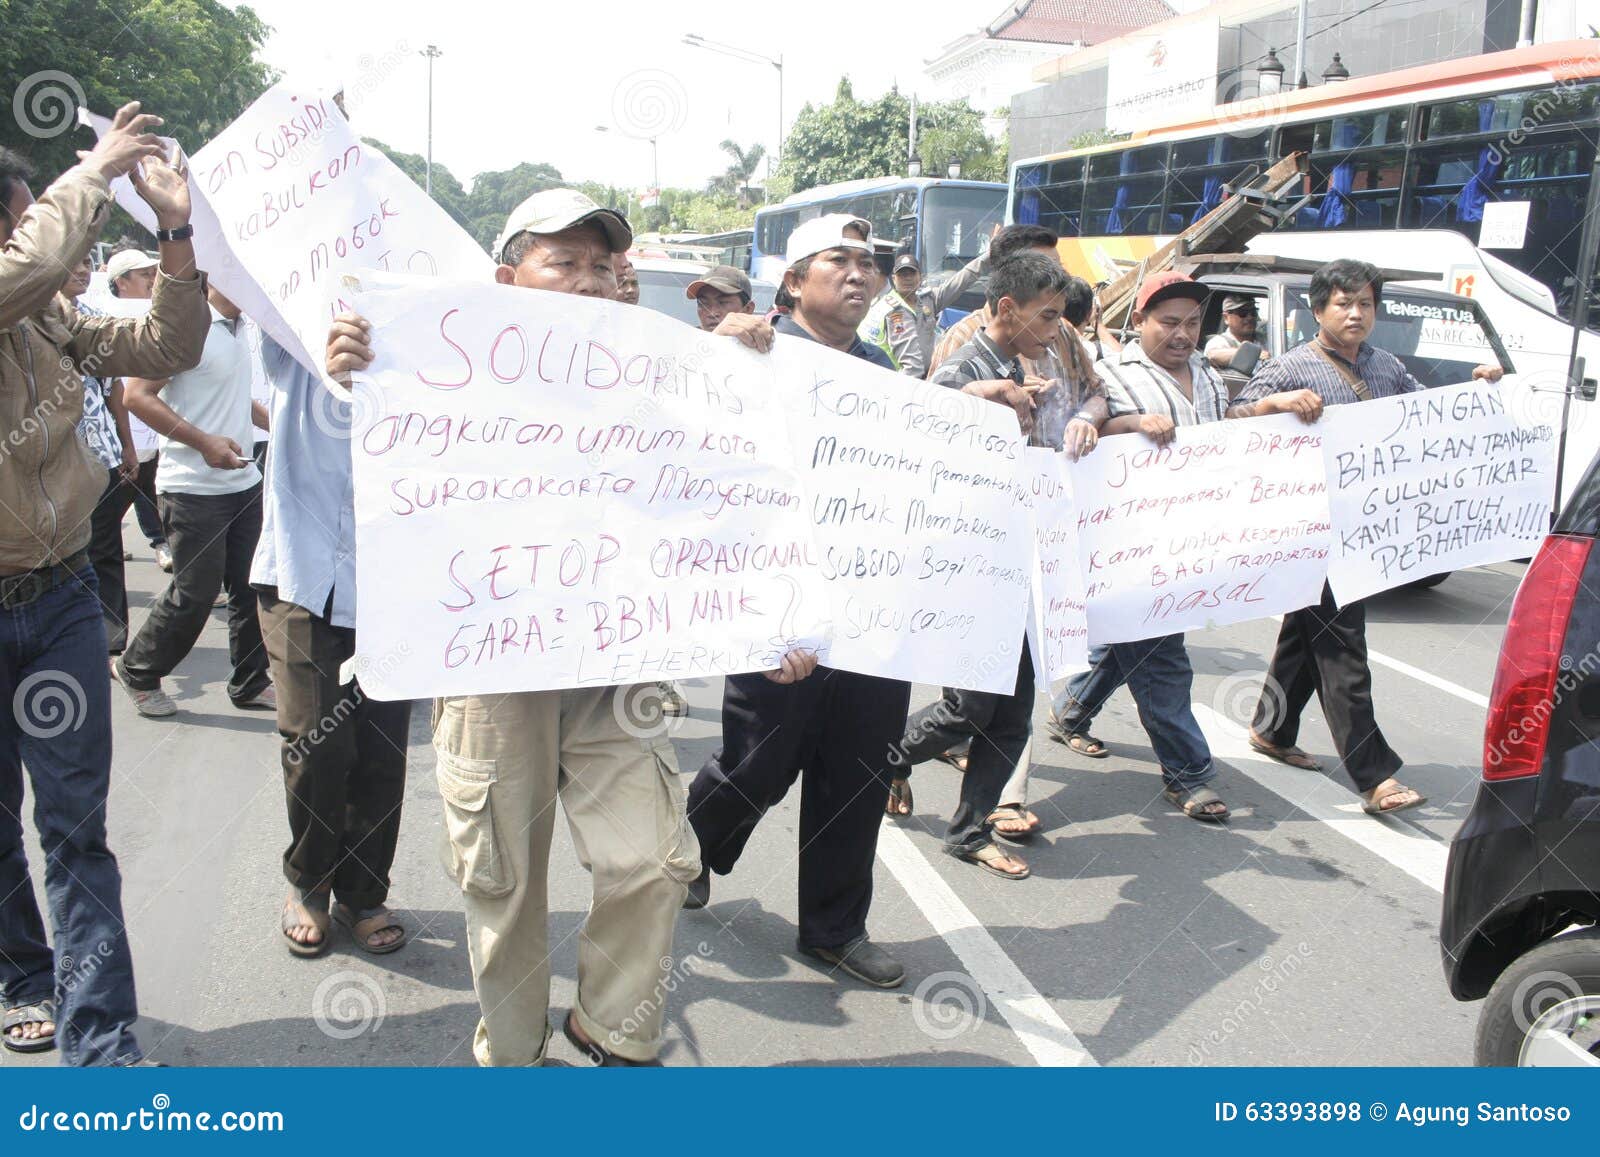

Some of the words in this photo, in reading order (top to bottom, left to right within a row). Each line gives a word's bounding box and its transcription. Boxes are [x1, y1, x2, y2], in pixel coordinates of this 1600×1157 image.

[1177, 78, 1205, 95] SOLO
[1382, 390, 1506, 443] JANGAN
[1248, 475, 1327, 504] BERIKAN
[1362, 467, 1465, 516] GULUNG
[1414, 495, 1505, 533] BUTUH
[438, 533, 622, 613] SETOP
[585, 594, 672, 652] BBM
[688, 585, 767, 627] NAIK
